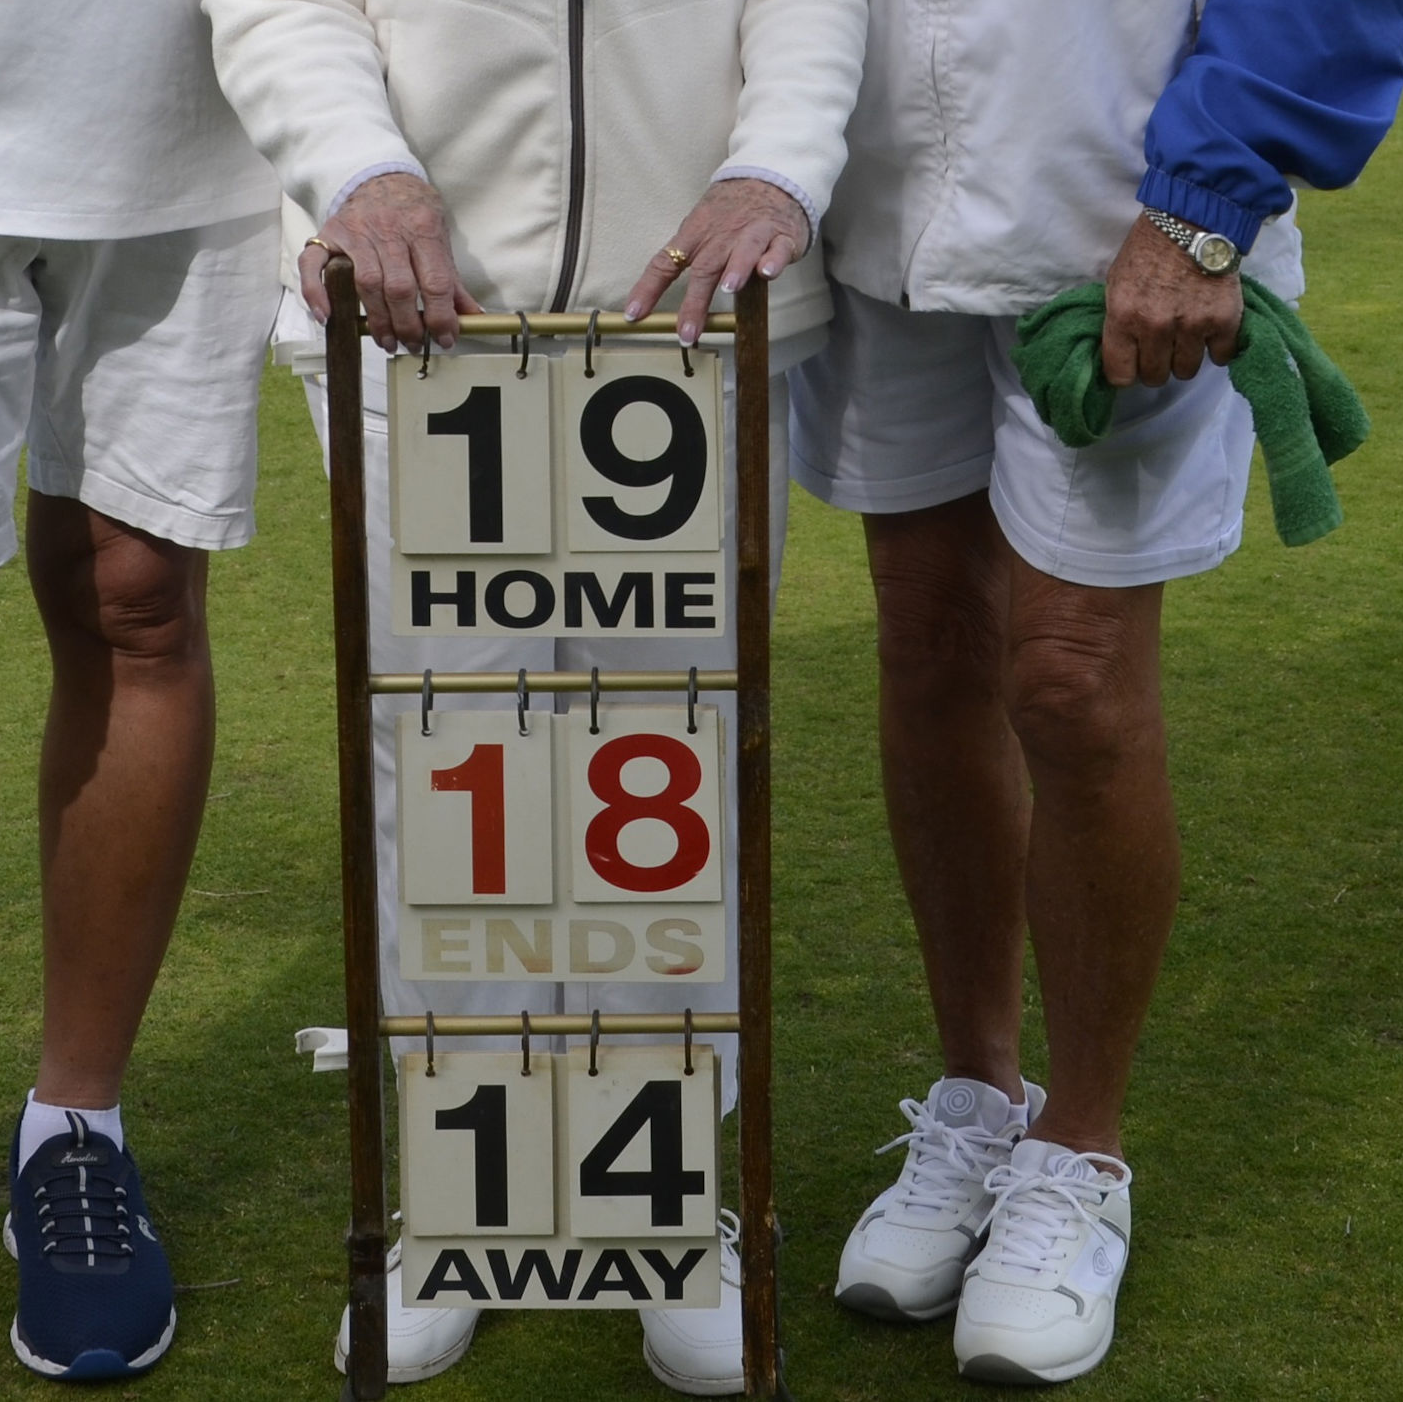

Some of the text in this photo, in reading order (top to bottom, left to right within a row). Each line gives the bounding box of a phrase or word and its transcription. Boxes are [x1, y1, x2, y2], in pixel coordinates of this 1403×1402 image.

[411, 570, 715, 628] HOME
[421, 918, 704, 975] ENDS
[416, 1248, 708, 1301] AWAY
